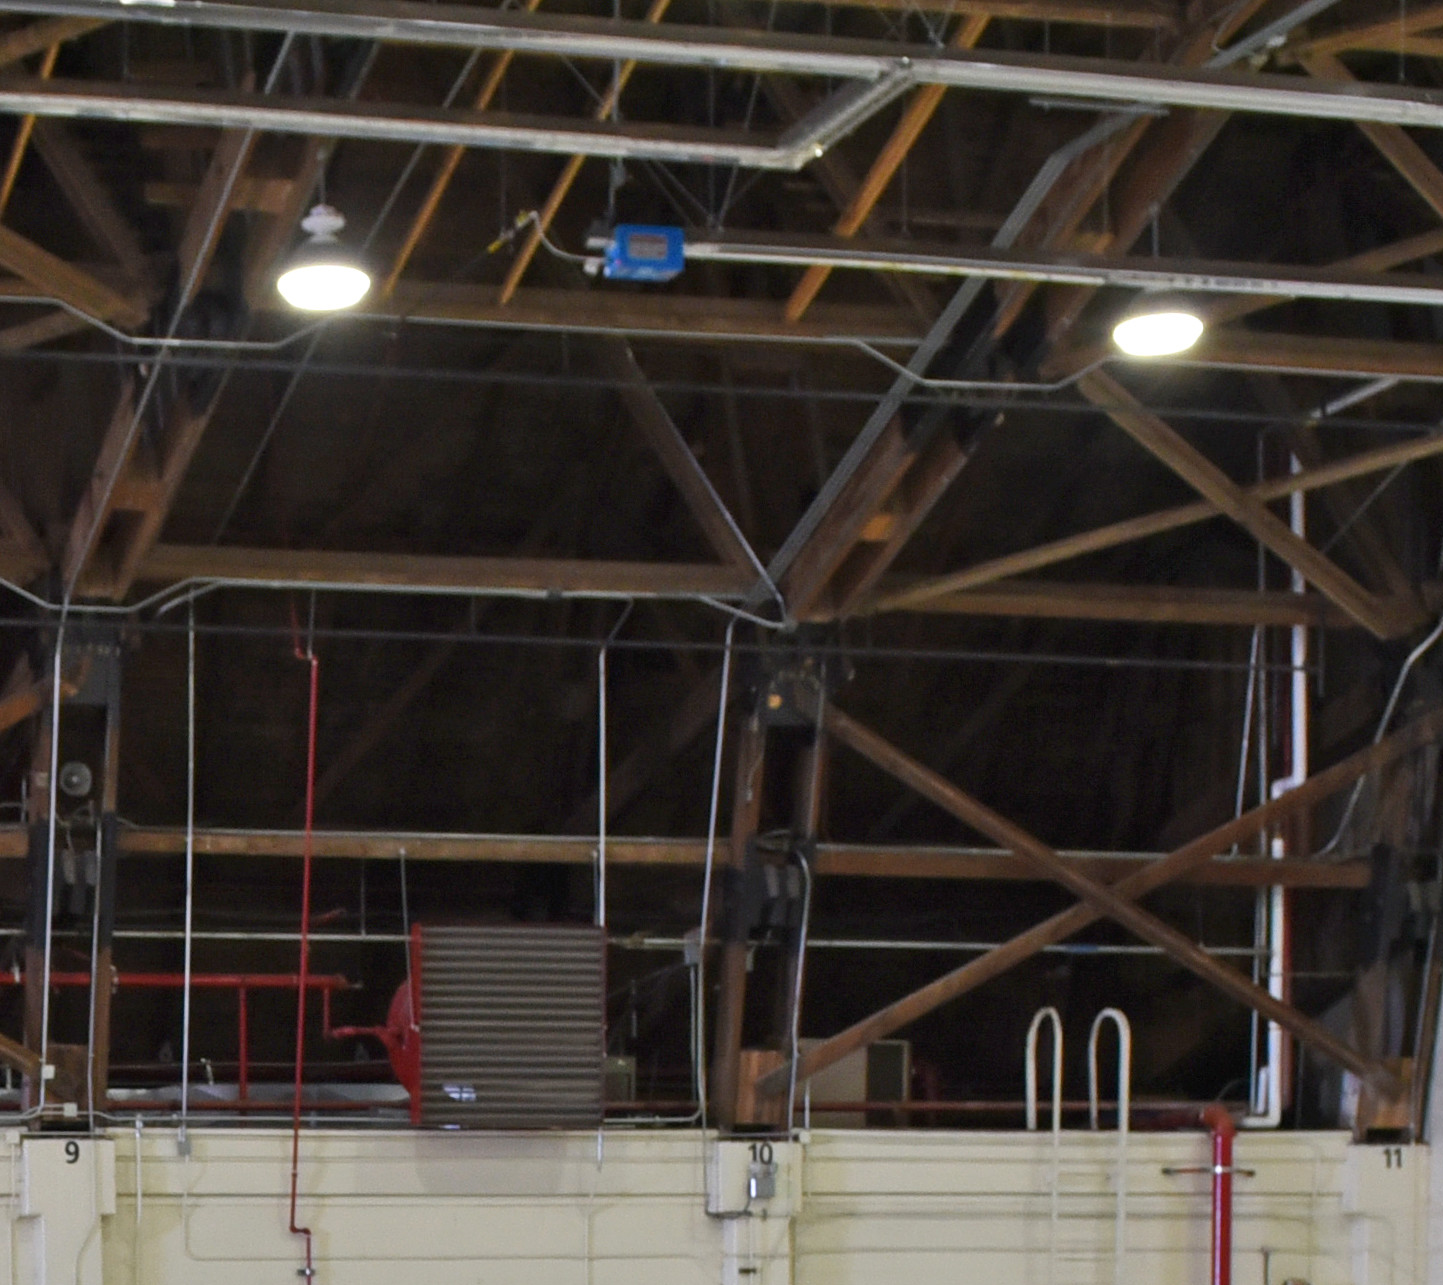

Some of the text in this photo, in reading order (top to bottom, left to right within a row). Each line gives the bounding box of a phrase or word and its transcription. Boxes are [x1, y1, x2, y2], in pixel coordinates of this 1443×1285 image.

[65, 1141, 80, 1164] 9
[748, 1142, 773, 1165] 10
[1384, 1148, 1402, 1169] 11
